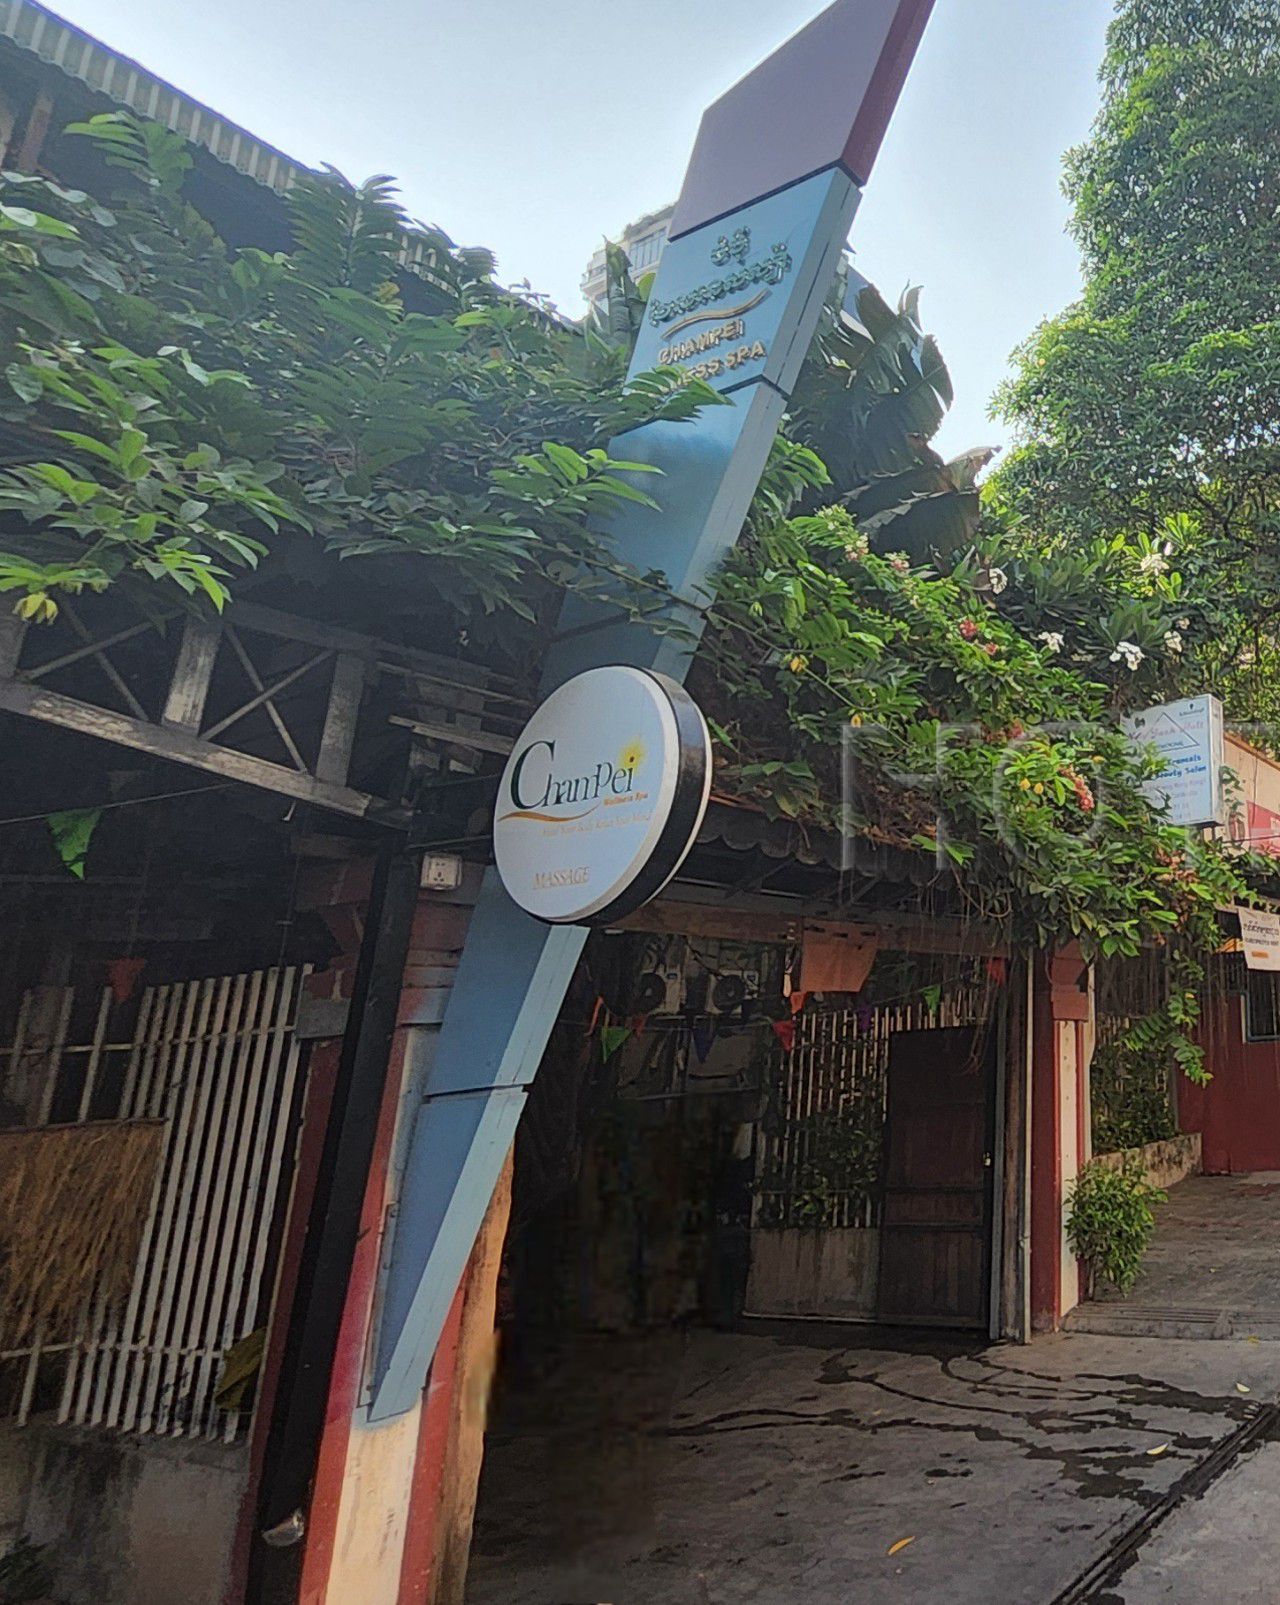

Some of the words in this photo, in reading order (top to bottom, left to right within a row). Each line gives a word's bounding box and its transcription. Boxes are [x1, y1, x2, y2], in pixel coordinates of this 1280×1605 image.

[659, 319, 745, 364] CHAMPEI
[724, 340, 767, 368] SPA
[535, 868, 588, 888] MASSAGE
